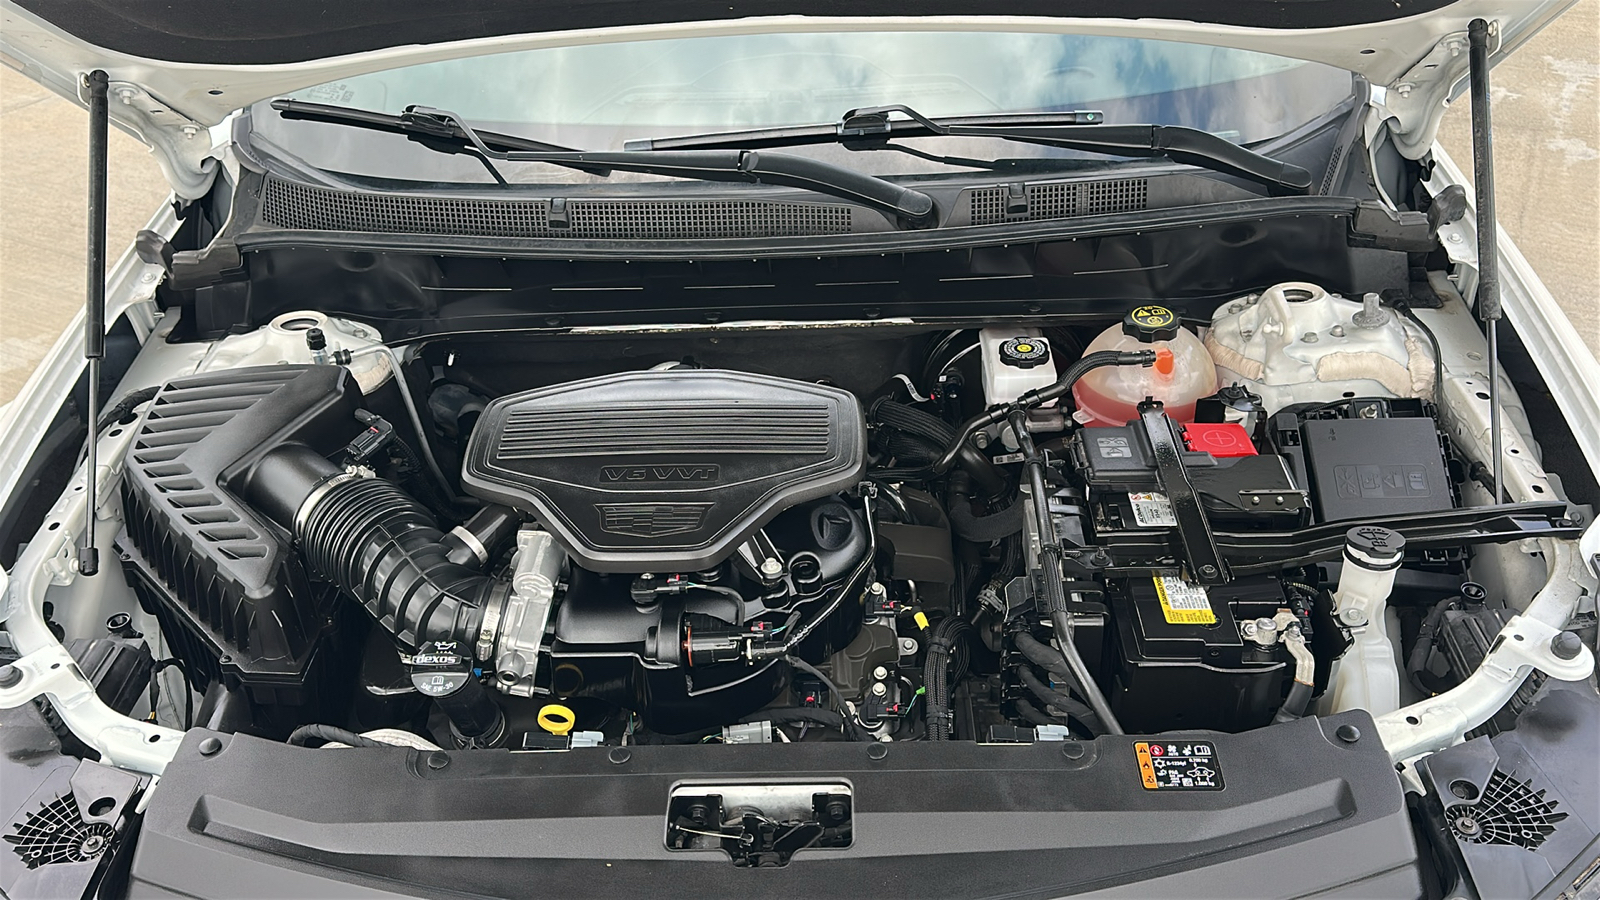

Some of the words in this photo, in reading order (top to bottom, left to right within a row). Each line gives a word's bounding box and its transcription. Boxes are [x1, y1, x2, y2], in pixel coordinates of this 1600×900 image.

[604, 467, 647, 480] V6
[652, 466, 716, 480] VVT
[416, 654, 457, 664] dexos
